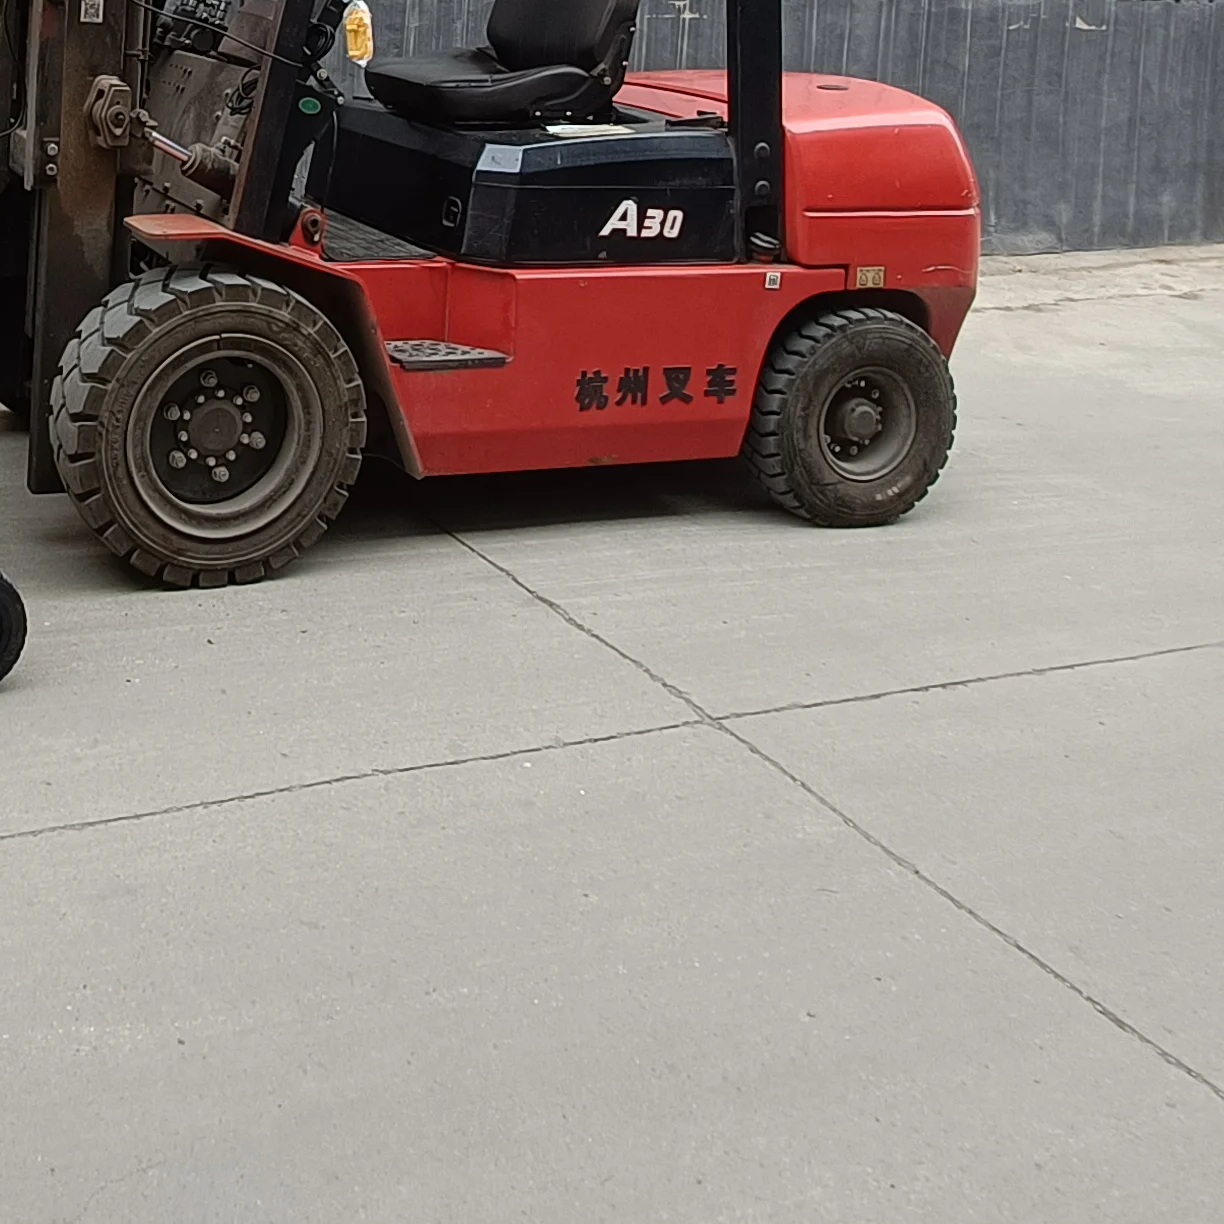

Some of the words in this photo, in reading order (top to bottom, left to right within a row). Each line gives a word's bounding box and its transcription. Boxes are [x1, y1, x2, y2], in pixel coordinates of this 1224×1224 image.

[598, 199, 684, 238] A30
[575, 363, 737, 412] 杭州叉车
